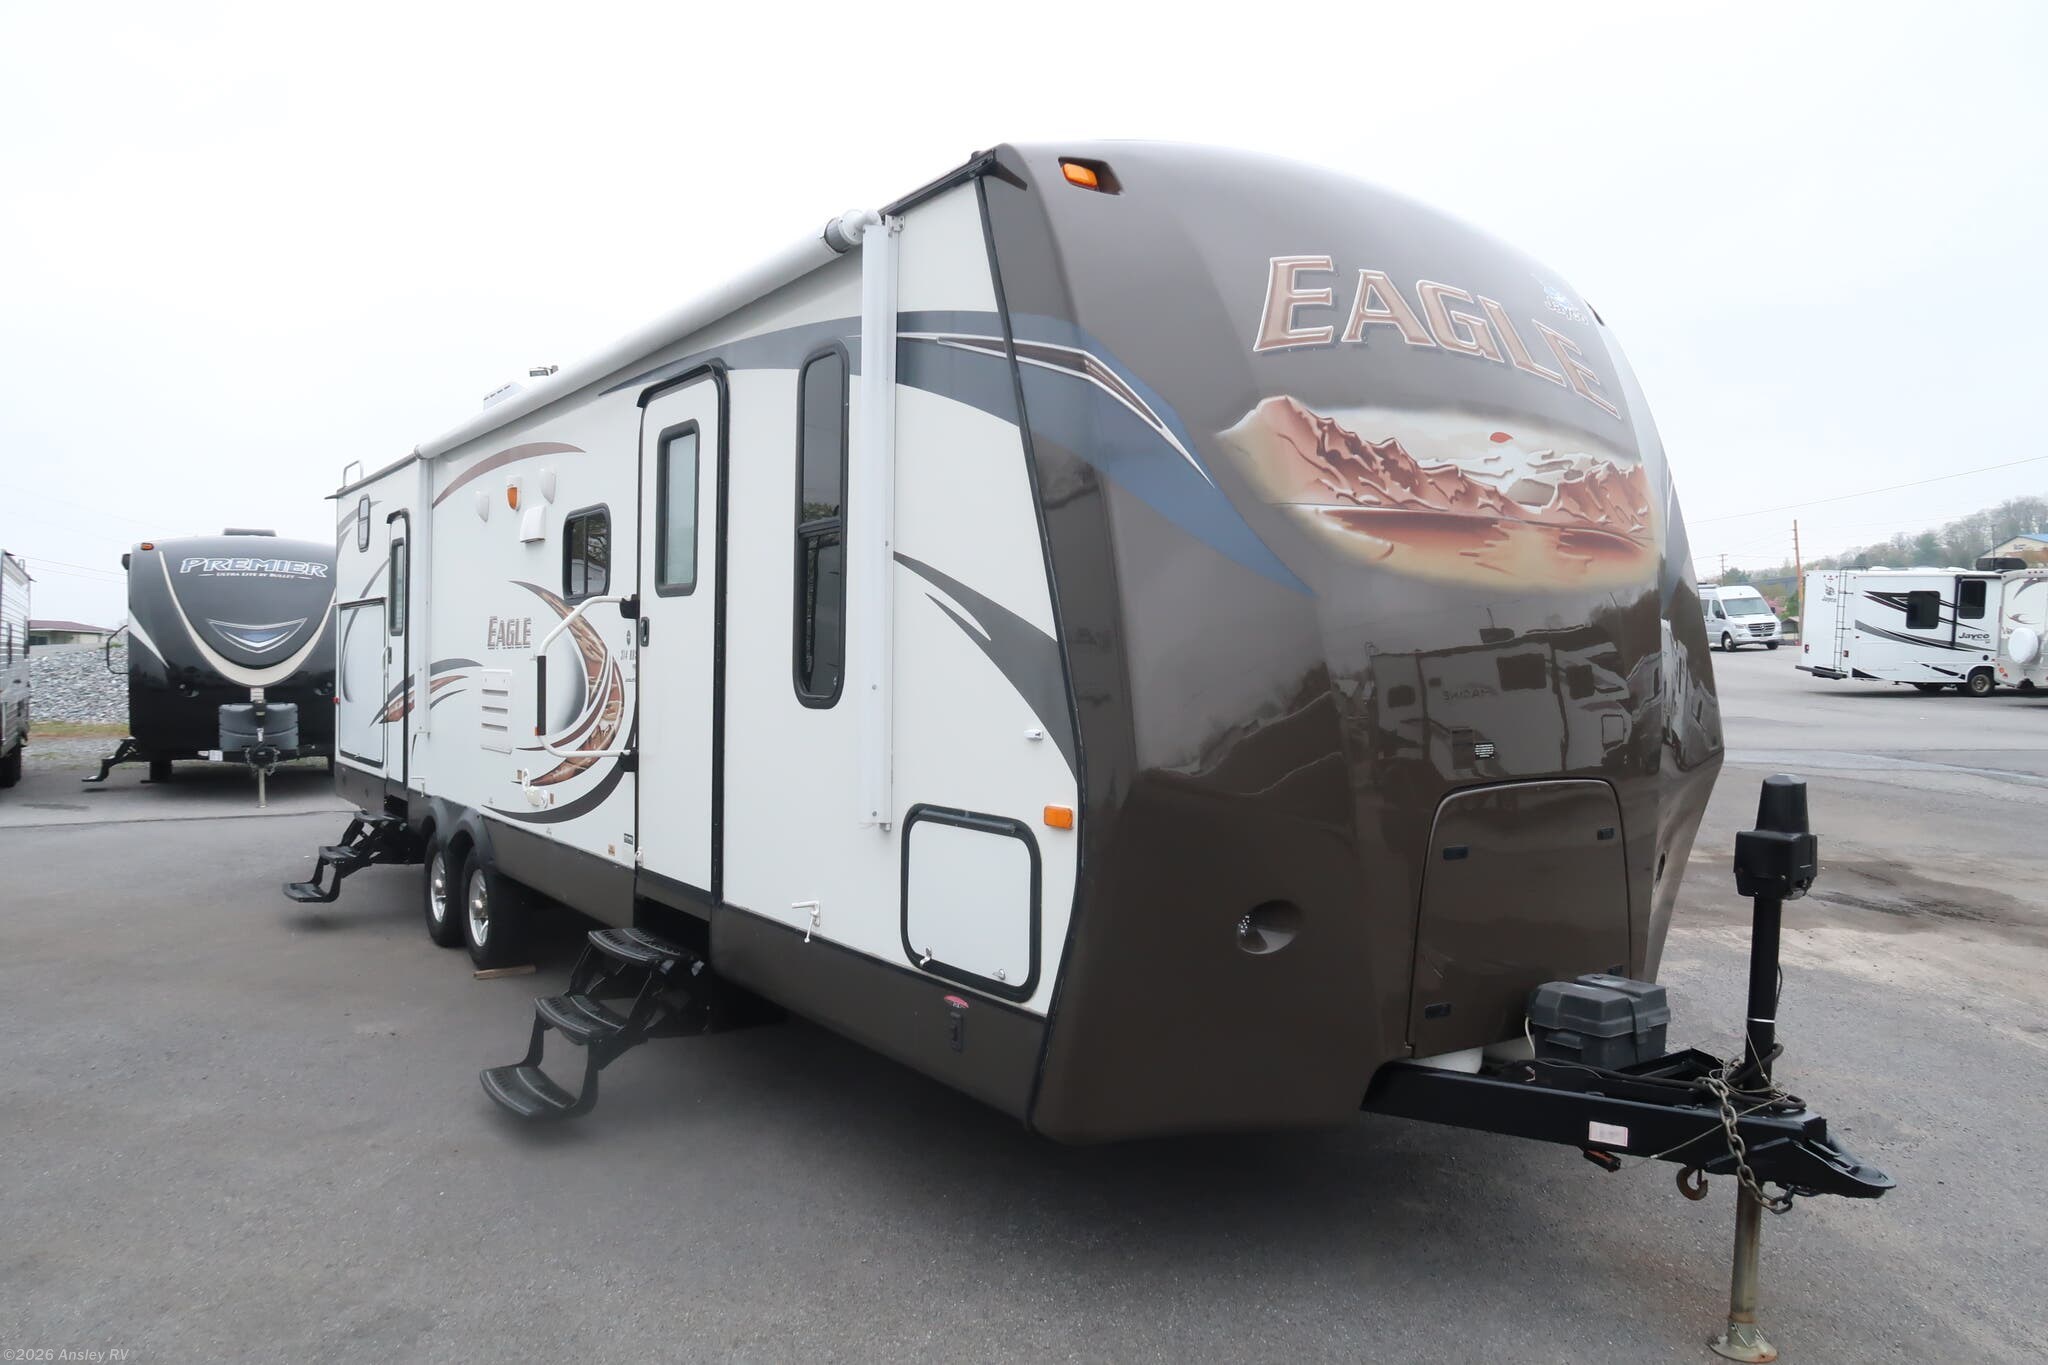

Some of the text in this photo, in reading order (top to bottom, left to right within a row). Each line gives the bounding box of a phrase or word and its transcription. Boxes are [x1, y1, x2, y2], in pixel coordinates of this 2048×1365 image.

[1253, 255, 1620, 420] EAGLE
[179, 557, 329, 578] PREMIER
[487, 616, 532, 650] EAGLE
[1958, 632, 1990, 641] Jayco
